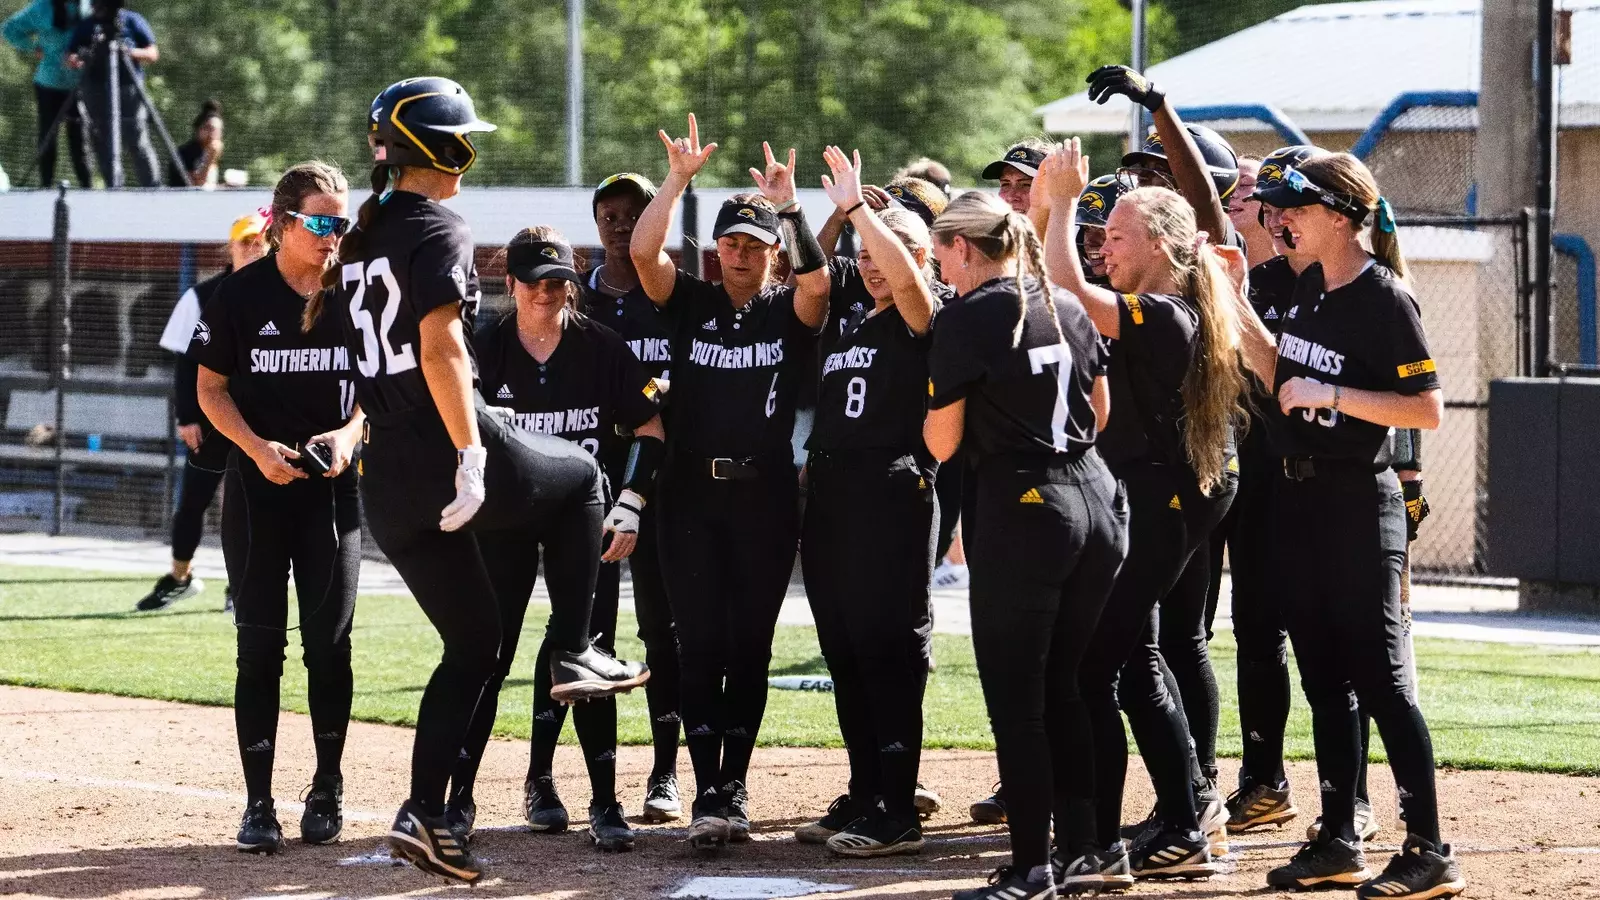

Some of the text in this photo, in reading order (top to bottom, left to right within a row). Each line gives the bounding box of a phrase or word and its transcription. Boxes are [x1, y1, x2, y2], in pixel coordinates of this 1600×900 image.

[341, 256, 418, 378] 32
[250, 345, 351, 373] SOUTHERN MI
[689, 337, 784, 369] SOUTHERN MISS
[843, 345, 878, 369] MISS
[1307, 342, 1345, 376] MISS
[764, 371, 780, 418] 6
[845, 376, 867, 418] 8
[1027, 343, 1073, 453] 7
[565, 406, 600, 432] MISS
[799, 680, 834, 692] EAS
